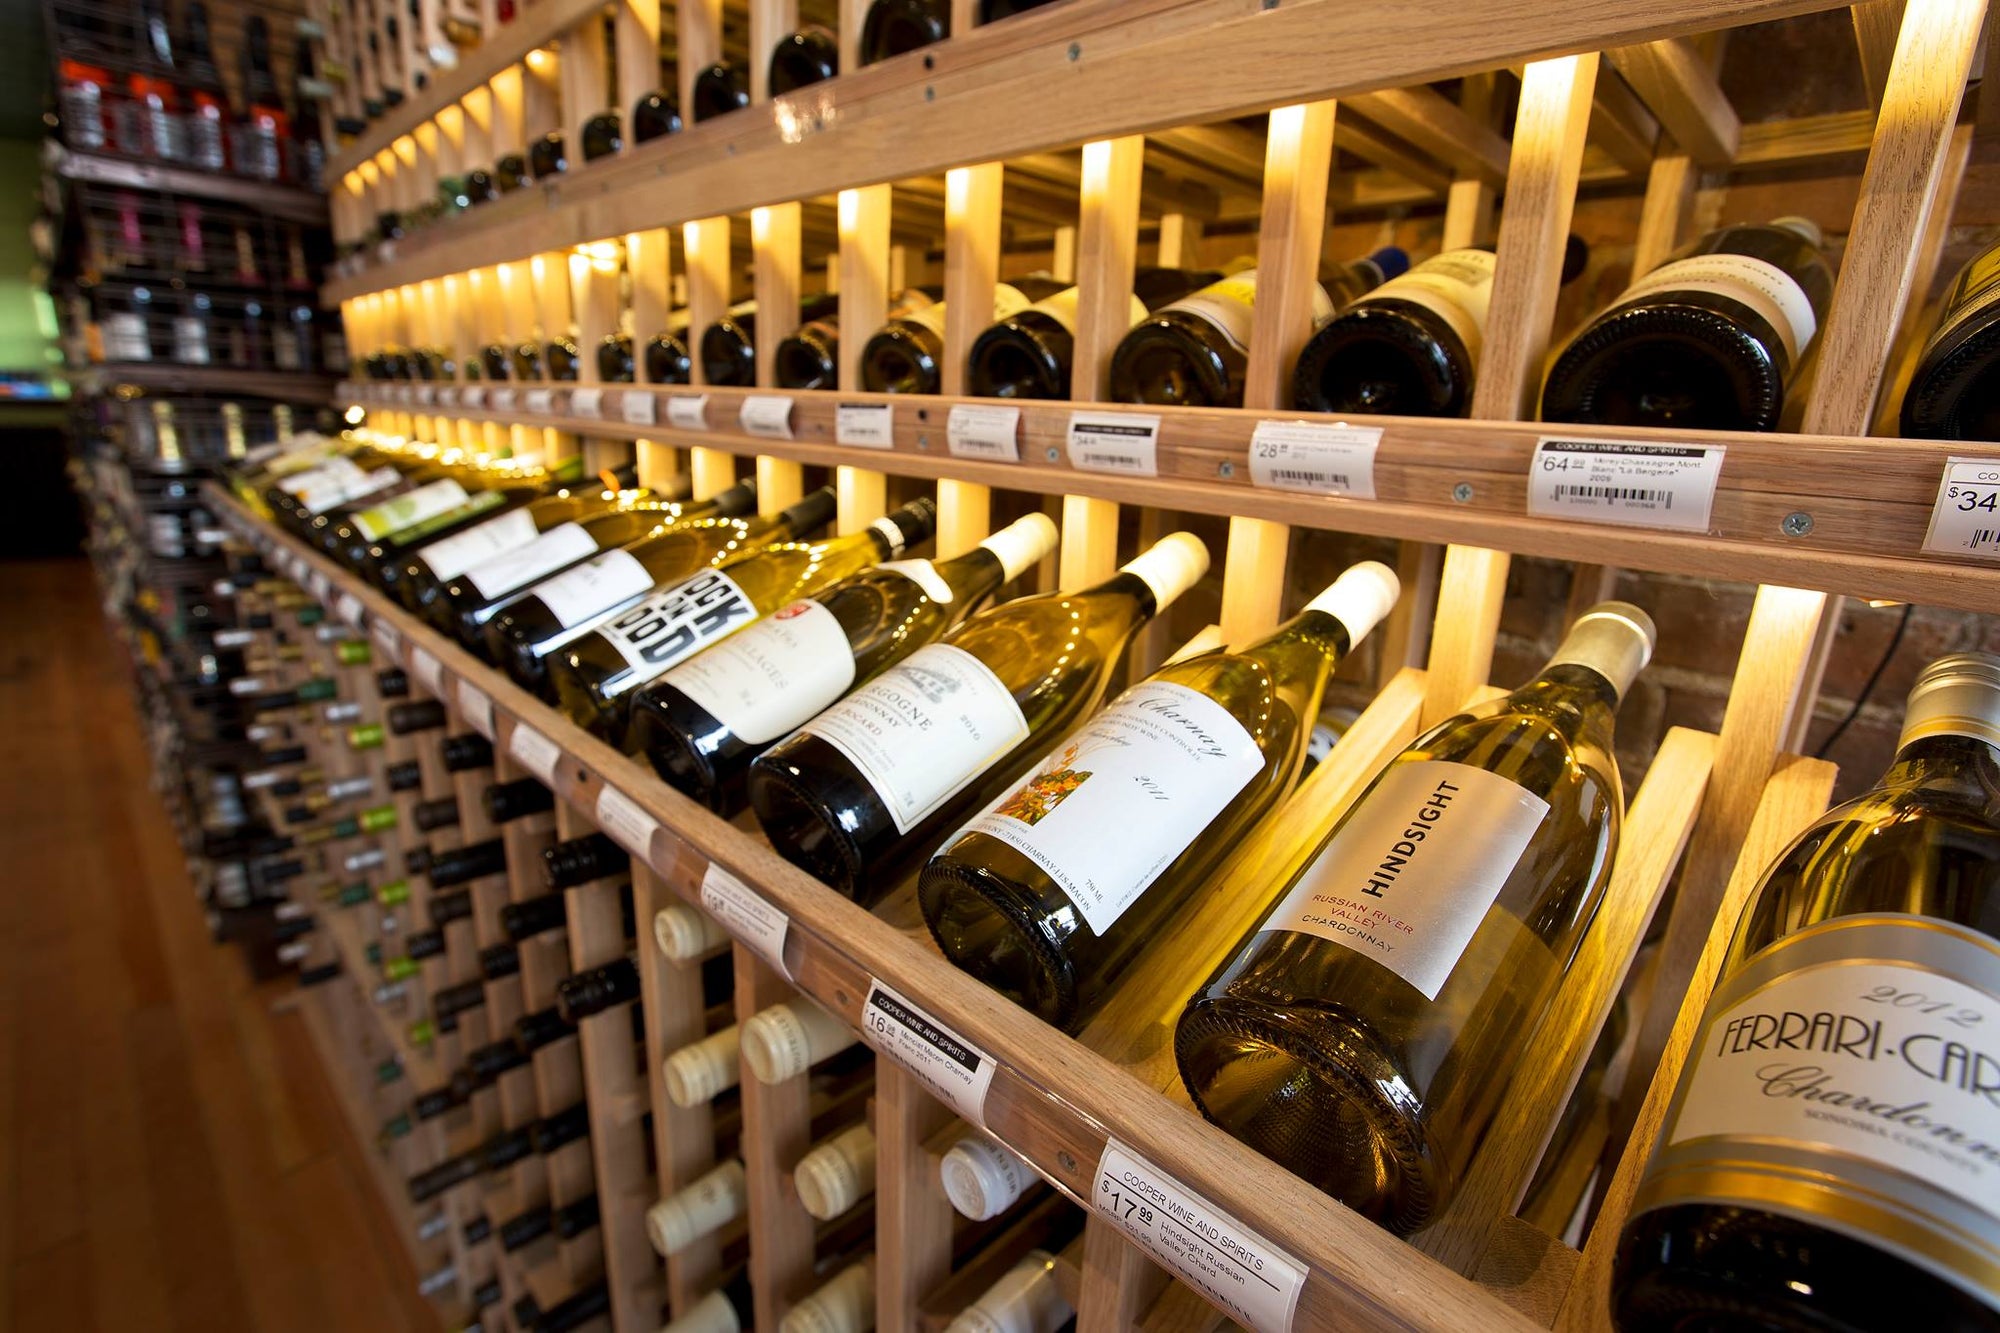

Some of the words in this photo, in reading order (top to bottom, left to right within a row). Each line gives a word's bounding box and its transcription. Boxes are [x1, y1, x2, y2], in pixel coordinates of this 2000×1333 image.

[1555, 442, 1595, 452] COOPER
[1599, 445, 1622, 453] WINE
[1625, 446, 1646, 454] AND
[1648, 447, 1687, 455] SPIRITS
[1948, 486, 1998, 512] $34
[1138, 698, 1227, 757] Charnay
[1133, 774, 1170, 801] 2011
[1361, 779, 1460, 899] HINDSIGHT
[1301, 914, 1396, 954] CHARDONNAY
[1312, 893, 1368, 913] RUSSIAN
[1372, 909, 1415, 936] RIVER
[1330, 906, 1378, 930] VALLEY
[877, 997, 906, 1021] COOPER
[906, 1014, 924, 1033] WINE
[923, 1028, 939, 1042] AND
[938, 1036, 967, 1061] SPIRITS
[1861, 984, 1984, 1030] 2012
[944, 1059, 975, 1086] Charnay
[1123, 1170, 1168, 1206] COOPER
[1168, 1197, 1196, 1226] WINE
[1195, 1219, 1220, 1242] AND
[1219, 1232, 1265, 1272] SPIRITS
[1158, 1233, 1187, 1258] Valley
[1186, 1252, 1217, 1279] Chard
[1160, 1220, 1205, 1258] Hindsight
[1205, 1249, 1246, 1287] Russian
